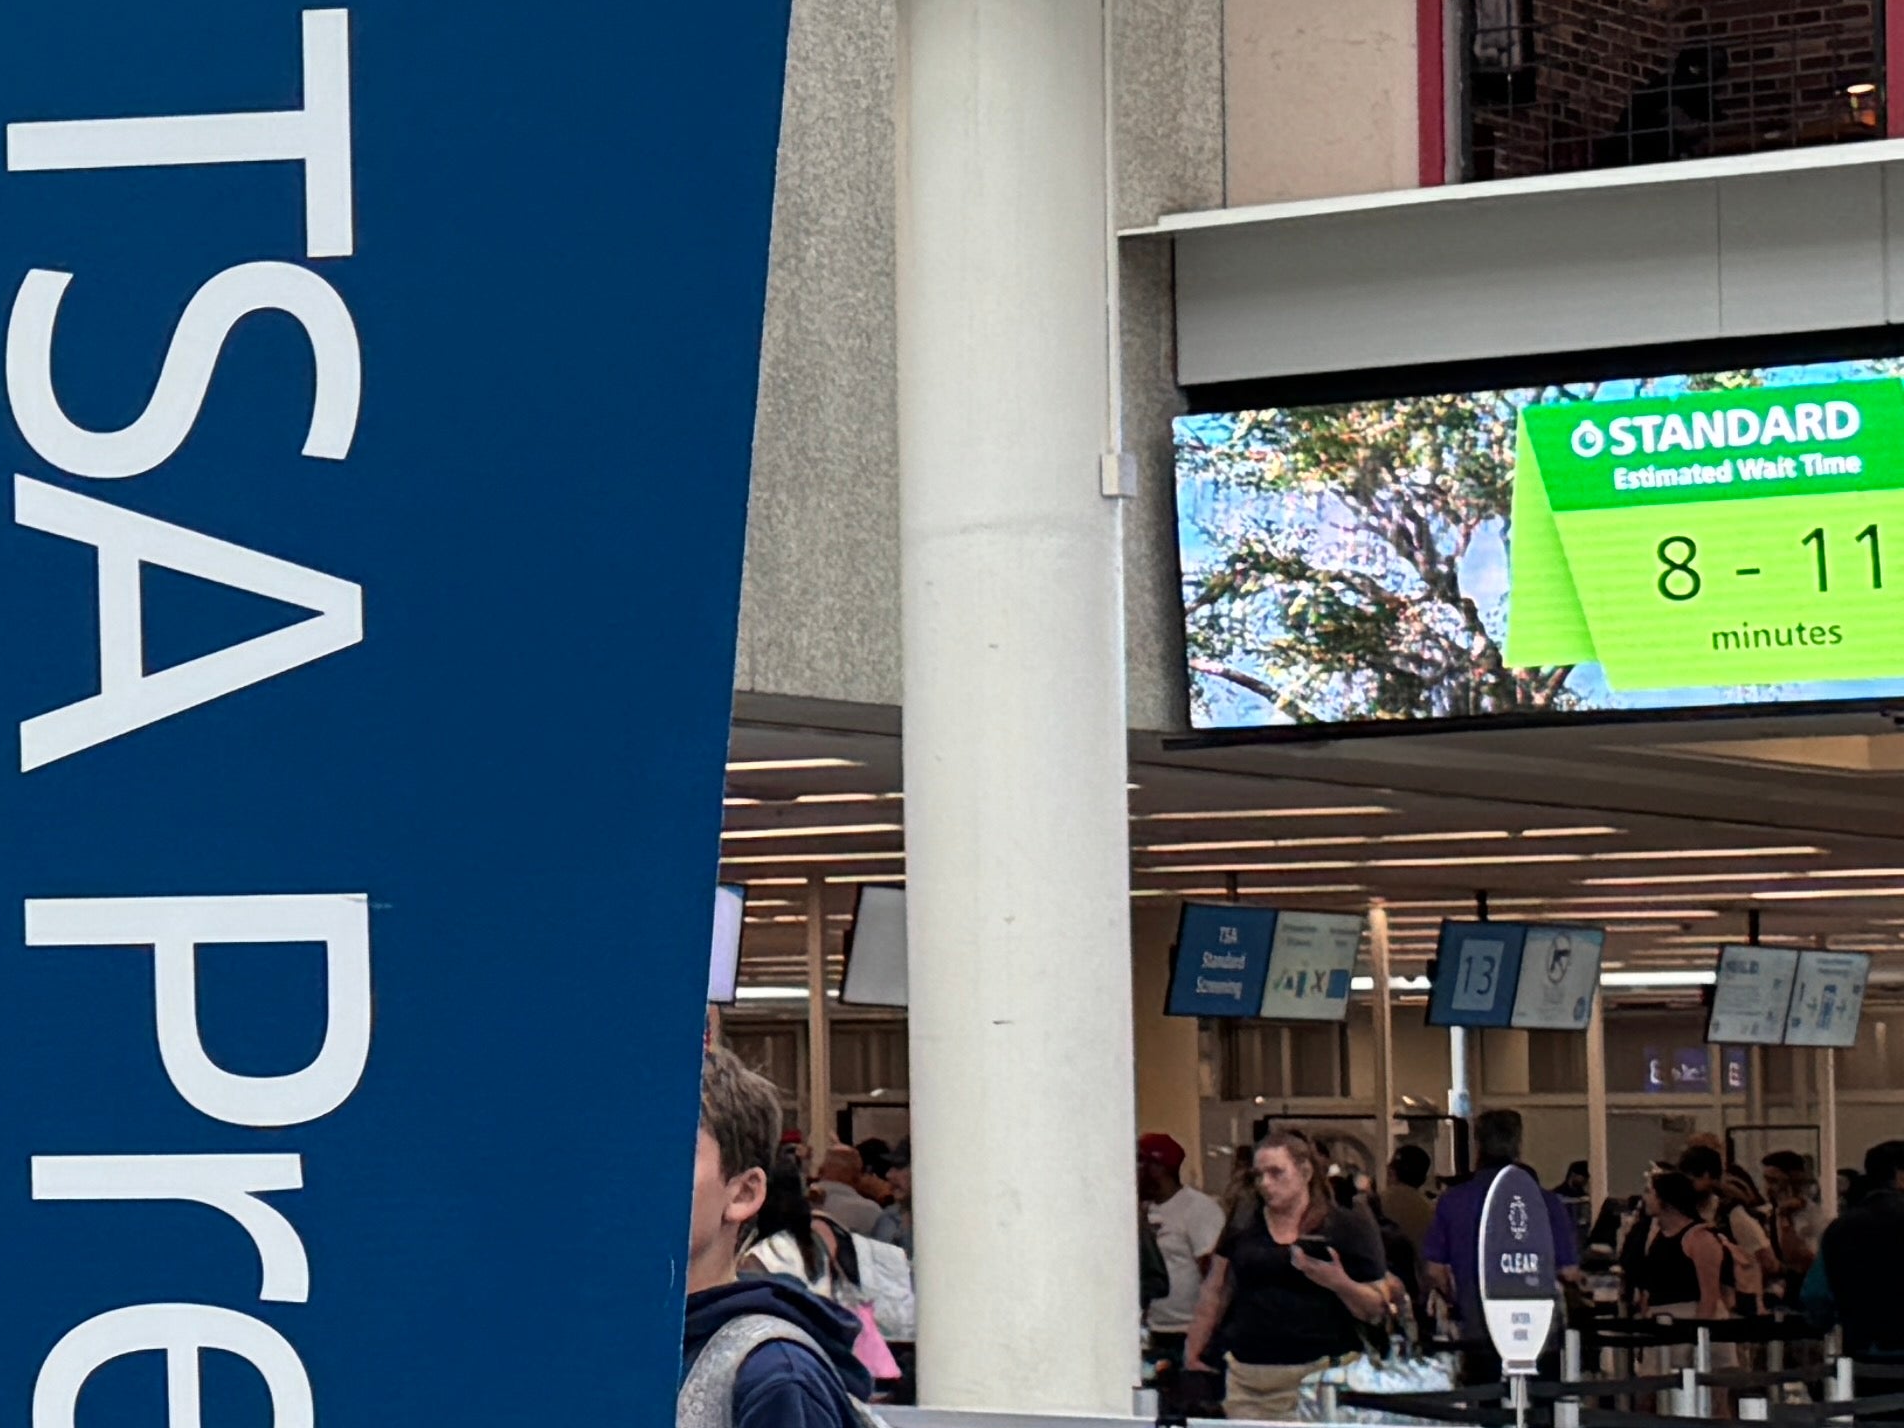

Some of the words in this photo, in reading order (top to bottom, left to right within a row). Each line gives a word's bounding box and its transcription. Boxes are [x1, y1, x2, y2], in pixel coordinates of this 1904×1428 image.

[5, 6, 364, 774] TSA
[1610, 400, 1861, 458] STANDARD
[1613, 458, 1733, 491] Estimated
[1735, 455, 1796, 482] Wait
[1800, 452, 1863, 477] Time
[1656, 535, 1702, 602] 8
[1735, 567, 1761, 576] -
[1800, 523, 1885, 593] 11
[1711, 619, 1844, 652] minutes
[1464, 955, 1496, 995] 13
[1500, 1252, 1539, 1273] CLEAR
